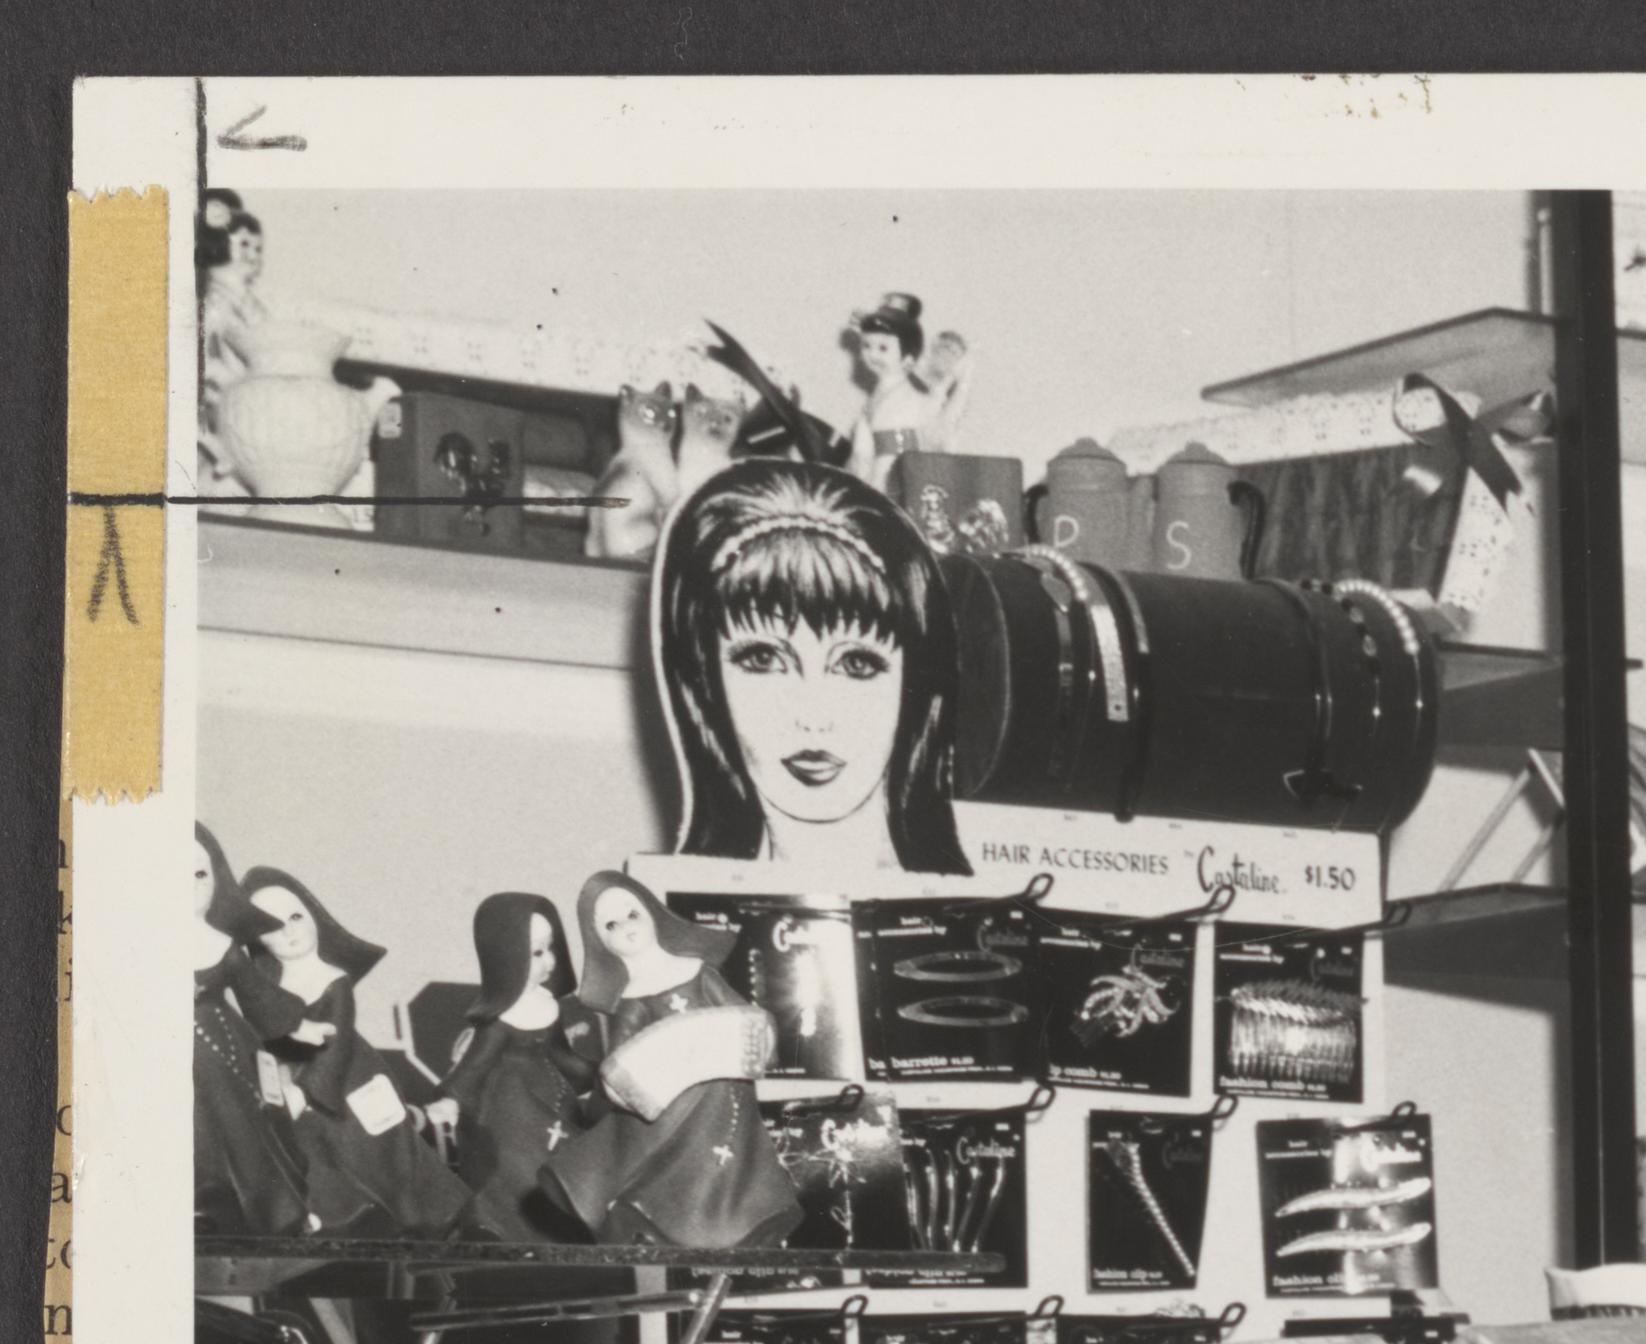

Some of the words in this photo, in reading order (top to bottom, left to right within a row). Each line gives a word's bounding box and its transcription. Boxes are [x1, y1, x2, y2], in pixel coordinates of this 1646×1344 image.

[1053, 514, 1081, 550] P
[1165, 519, 1193, 570] S
[982, 842, 1030, 864] HAIR
[1039, 846, 1170, 876] ACCESSORIES
[1304, 864, 1357, 892] $1.50
